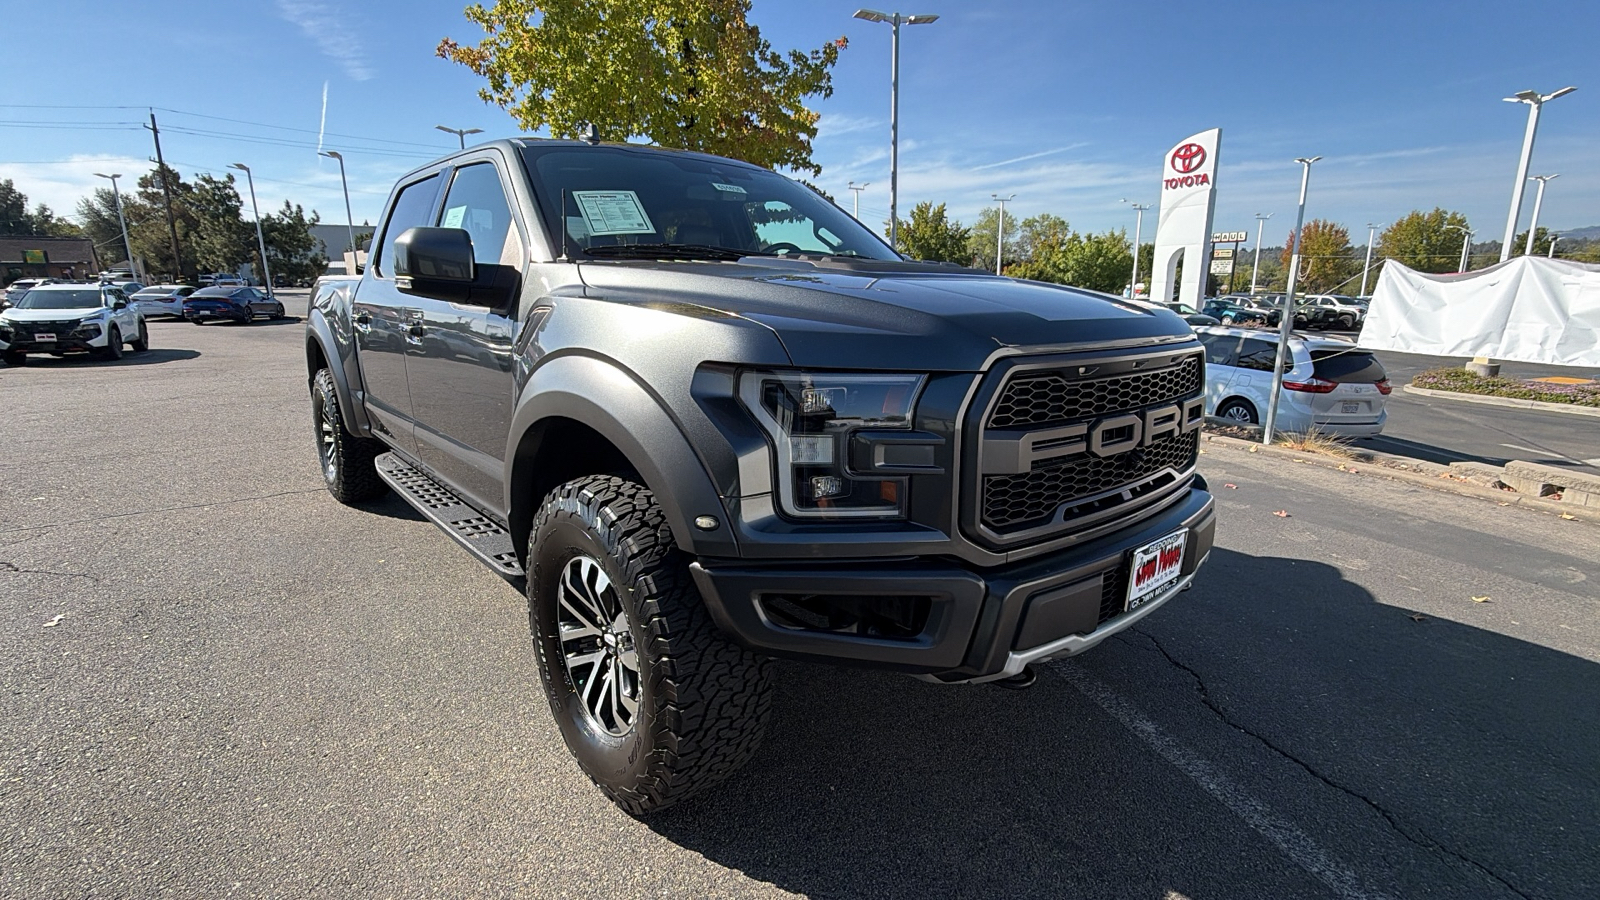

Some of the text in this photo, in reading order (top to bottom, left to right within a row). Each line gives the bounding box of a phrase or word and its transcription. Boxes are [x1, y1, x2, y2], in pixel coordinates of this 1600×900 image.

[1164, 173, 1210, 190] TOYOTA
[1018, 396, 1206, 473] FORD
[1149, 535, 1178, 553] REDDING
